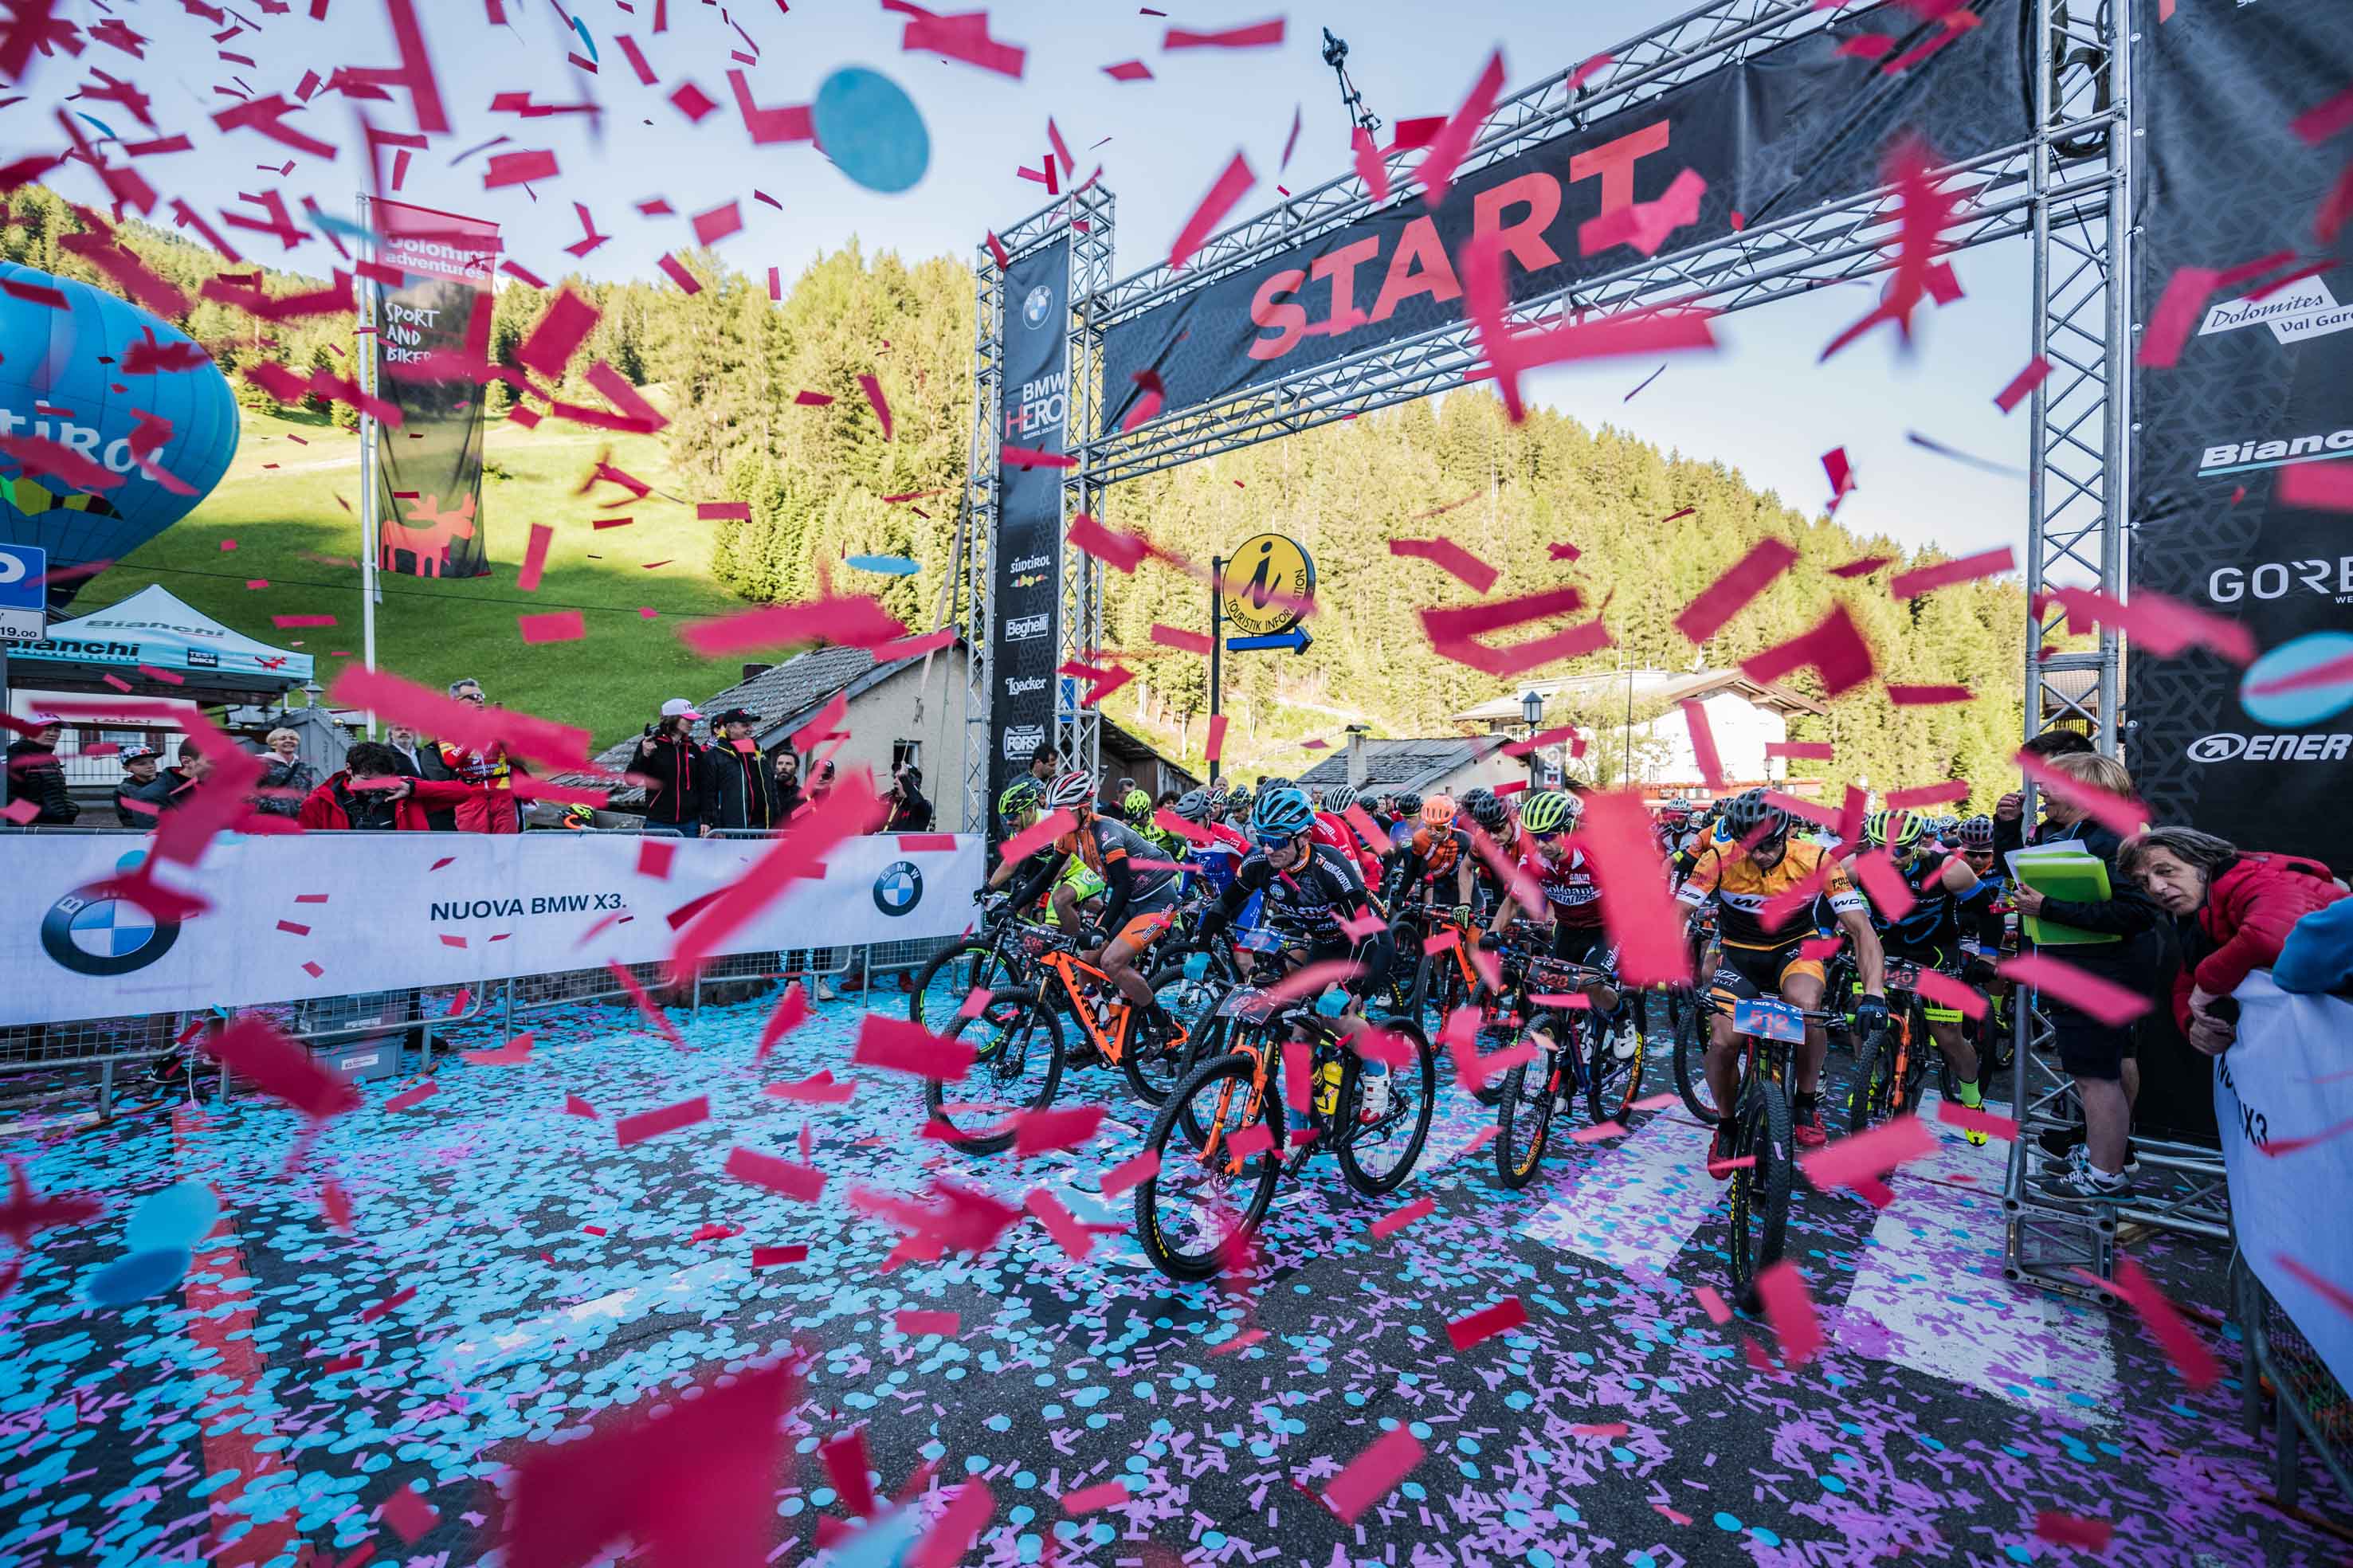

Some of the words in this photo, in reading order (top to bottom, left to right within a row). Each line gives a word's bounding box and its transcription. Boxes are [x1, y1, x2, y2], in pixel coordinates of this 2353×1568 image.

[1248, 118, 1669, 361] START
[386, 250, 485, 280] adventures
[384, 302, 441, 329] SPORT
[2211, 295, 2324, 327] Dolomites
[386, 324, 422, 346] AND
[2280, 319, 2310, 332] Val
[1023, 370, 1065, 402] BMW
[1006, 394, 1066, 439] HERO
[1228, 598, 1262, 632] TOURISTIK
[1265, 568, 1305, 630] INFORTION
[84, 619, 225, 637] Bianchi
[1006, 616, 1048, 637] Beghelli
[1006, 676, 1047, 696] Loacker
[1006, 735, 1042, 751] FORST
[430, 899, 524, 921] NUOVA
[531, 894, 590, 915] BMW
[1834, 897, 1861, 907] WD
[1749, 1009, 1789, 1033] 512
